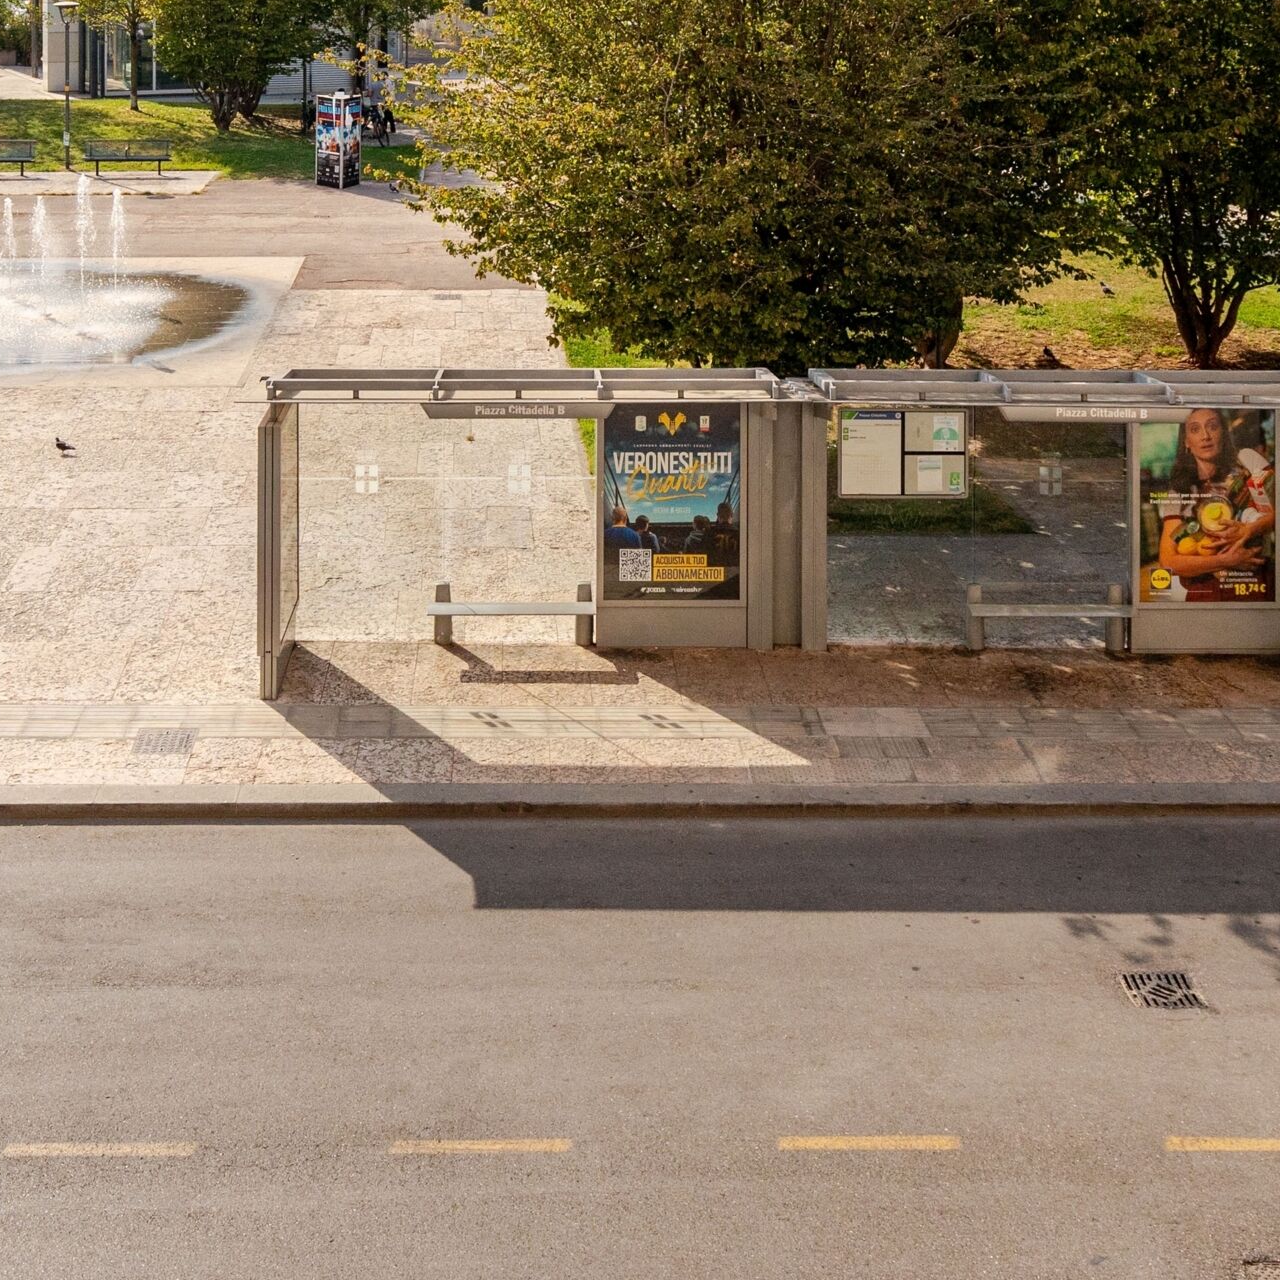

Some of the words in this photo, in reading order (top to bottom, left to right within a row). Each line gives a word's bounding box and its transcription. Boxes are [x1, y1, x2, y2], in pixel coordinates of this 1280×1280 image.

[474, 405, 506, 416] Piazza
[508, 404, 555, 415] Cittadella
[557, 405, 566, 415] B
[1055, 407, 1088, 418] Piazza
[1090, 407, 1137, 418] Cittadella
[1139, 408, 1149, 419] B
[613, 451, 694, 474] VERONESI
[697, 451, 732, 474] TUTI
[626, 459, 709, 502] Quanti
[655, 556, 685, 565] ACQUISTA
[685, 556, 691, 565] IL
[692, 556, 705, 565] TUO
[655, 568, 722, 580] ABBONAMENTO!
